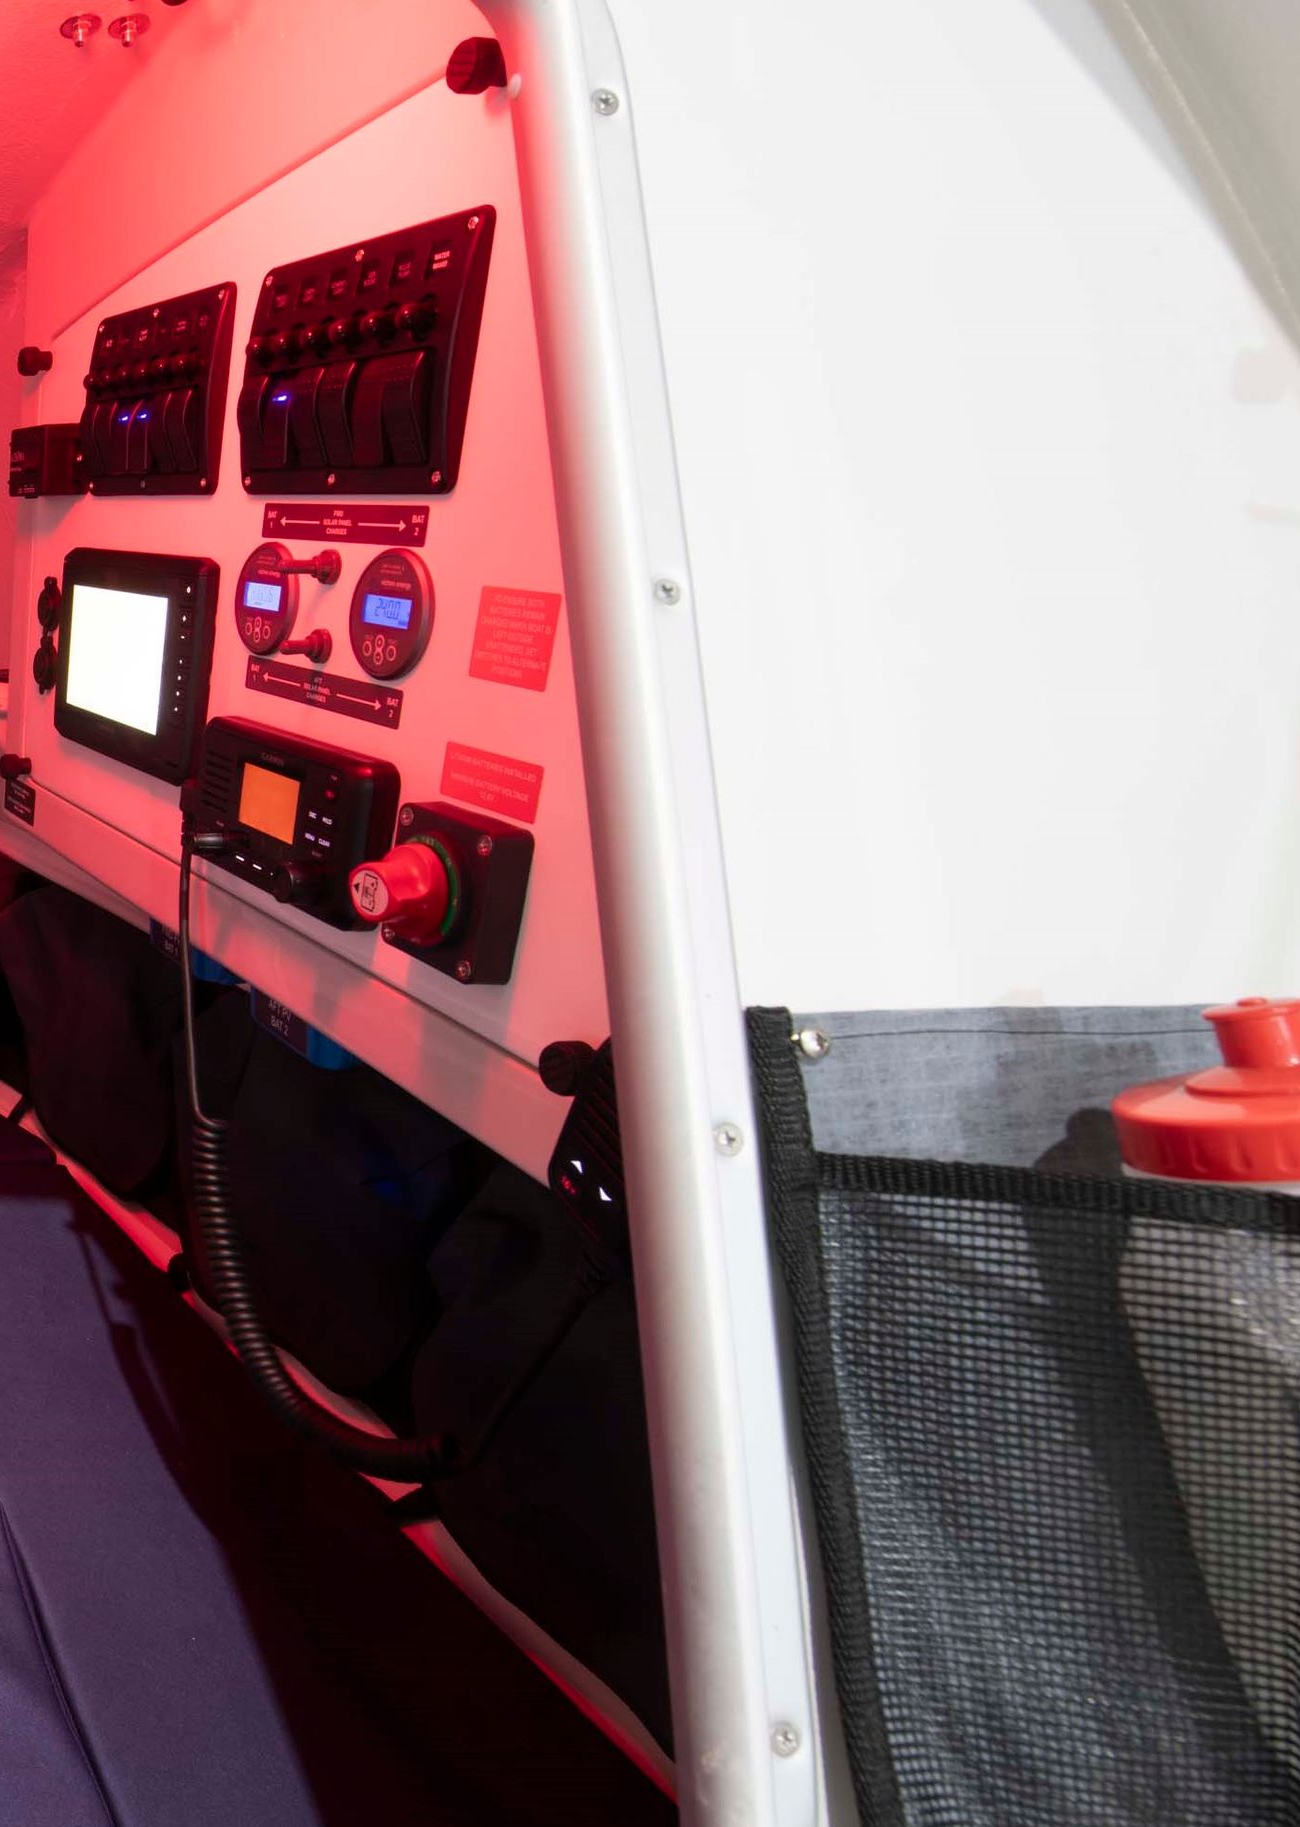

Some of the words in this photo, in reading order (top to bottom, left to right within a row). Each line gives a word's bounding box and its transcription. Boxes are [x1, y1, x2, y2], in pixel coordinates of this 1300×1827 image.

[411, 514, 425, 523] BAT
[386, 697, 399, 707] BAT
[271, 1015, 282, 1030] BAT
